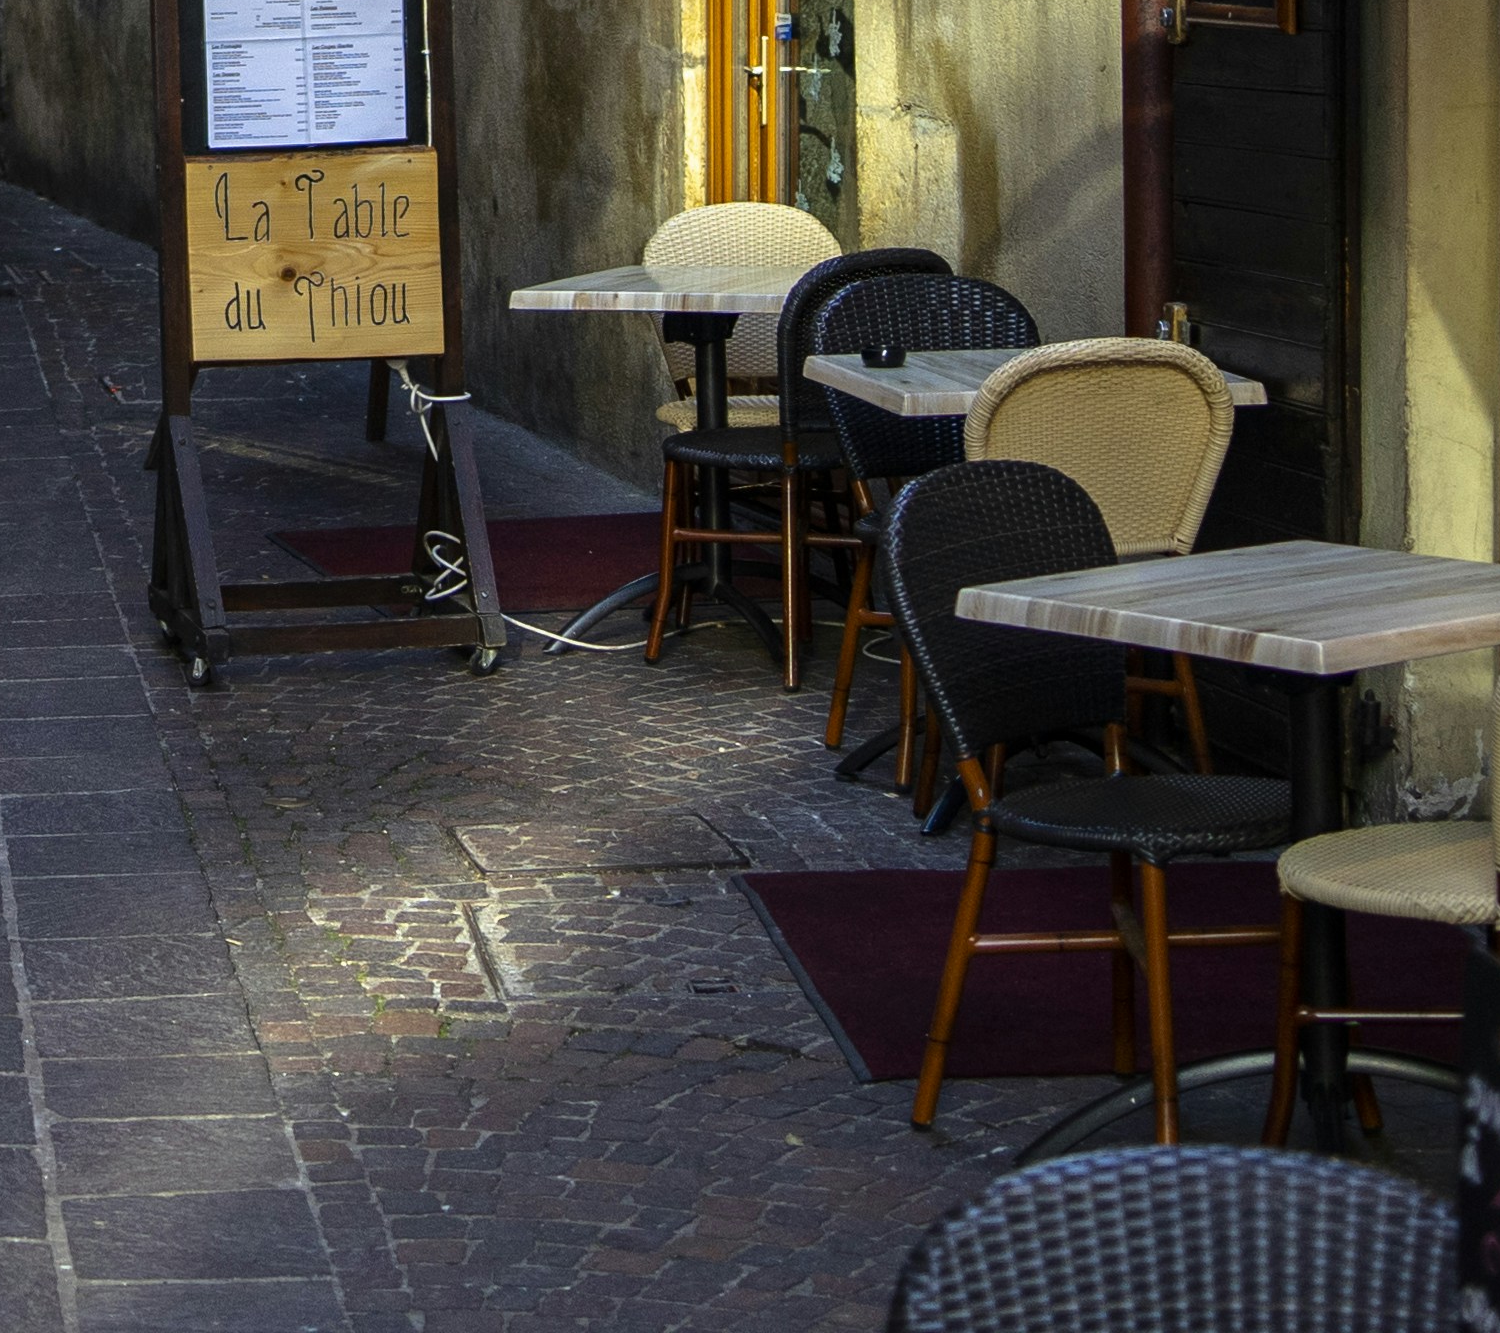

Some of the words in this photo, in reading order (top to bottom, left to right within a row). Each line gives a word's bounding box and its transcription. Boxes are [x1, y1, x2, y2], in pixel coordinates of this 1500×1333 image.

[213, 172, 271, 243] La
[294, 170, 411, 240] Table
[224, 280, 267, 333] du
[293, 271, 411, 343] Thiou
